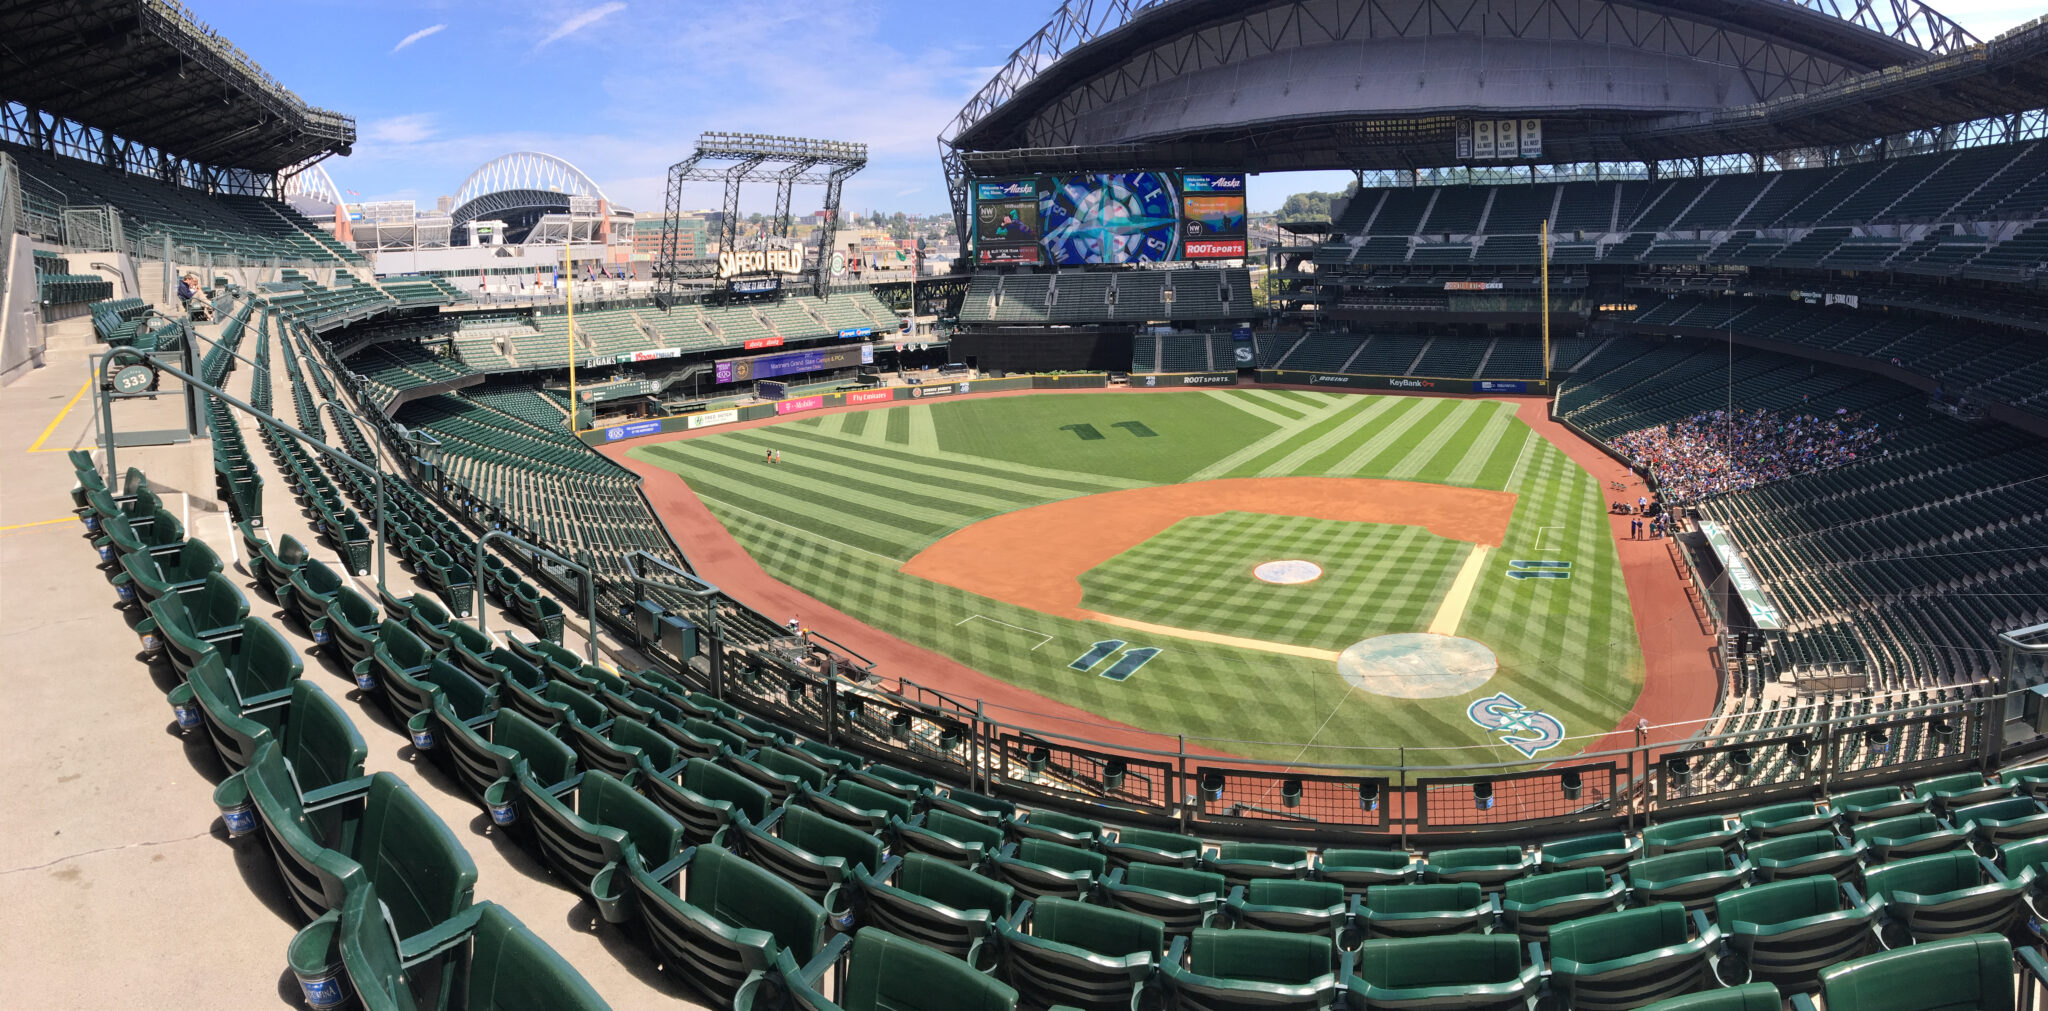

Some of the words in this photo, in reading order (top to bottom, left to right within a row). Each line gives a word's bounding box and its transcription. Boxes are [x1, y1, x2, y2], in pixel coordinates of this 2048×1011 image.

[1003, 183, 1033, 194] Alaska
[1211, 177, 1240, 188] Alaska
[719, 250, 765, 279] SAFECO
[766, 249, 802, 274] FIELD
[122, 373, 146, 389] 333
[1389, 378, 1421, 387] KeyBank
[1059, 420, 1160, 441] 11
[1067, 639, 1163, 681] 11
